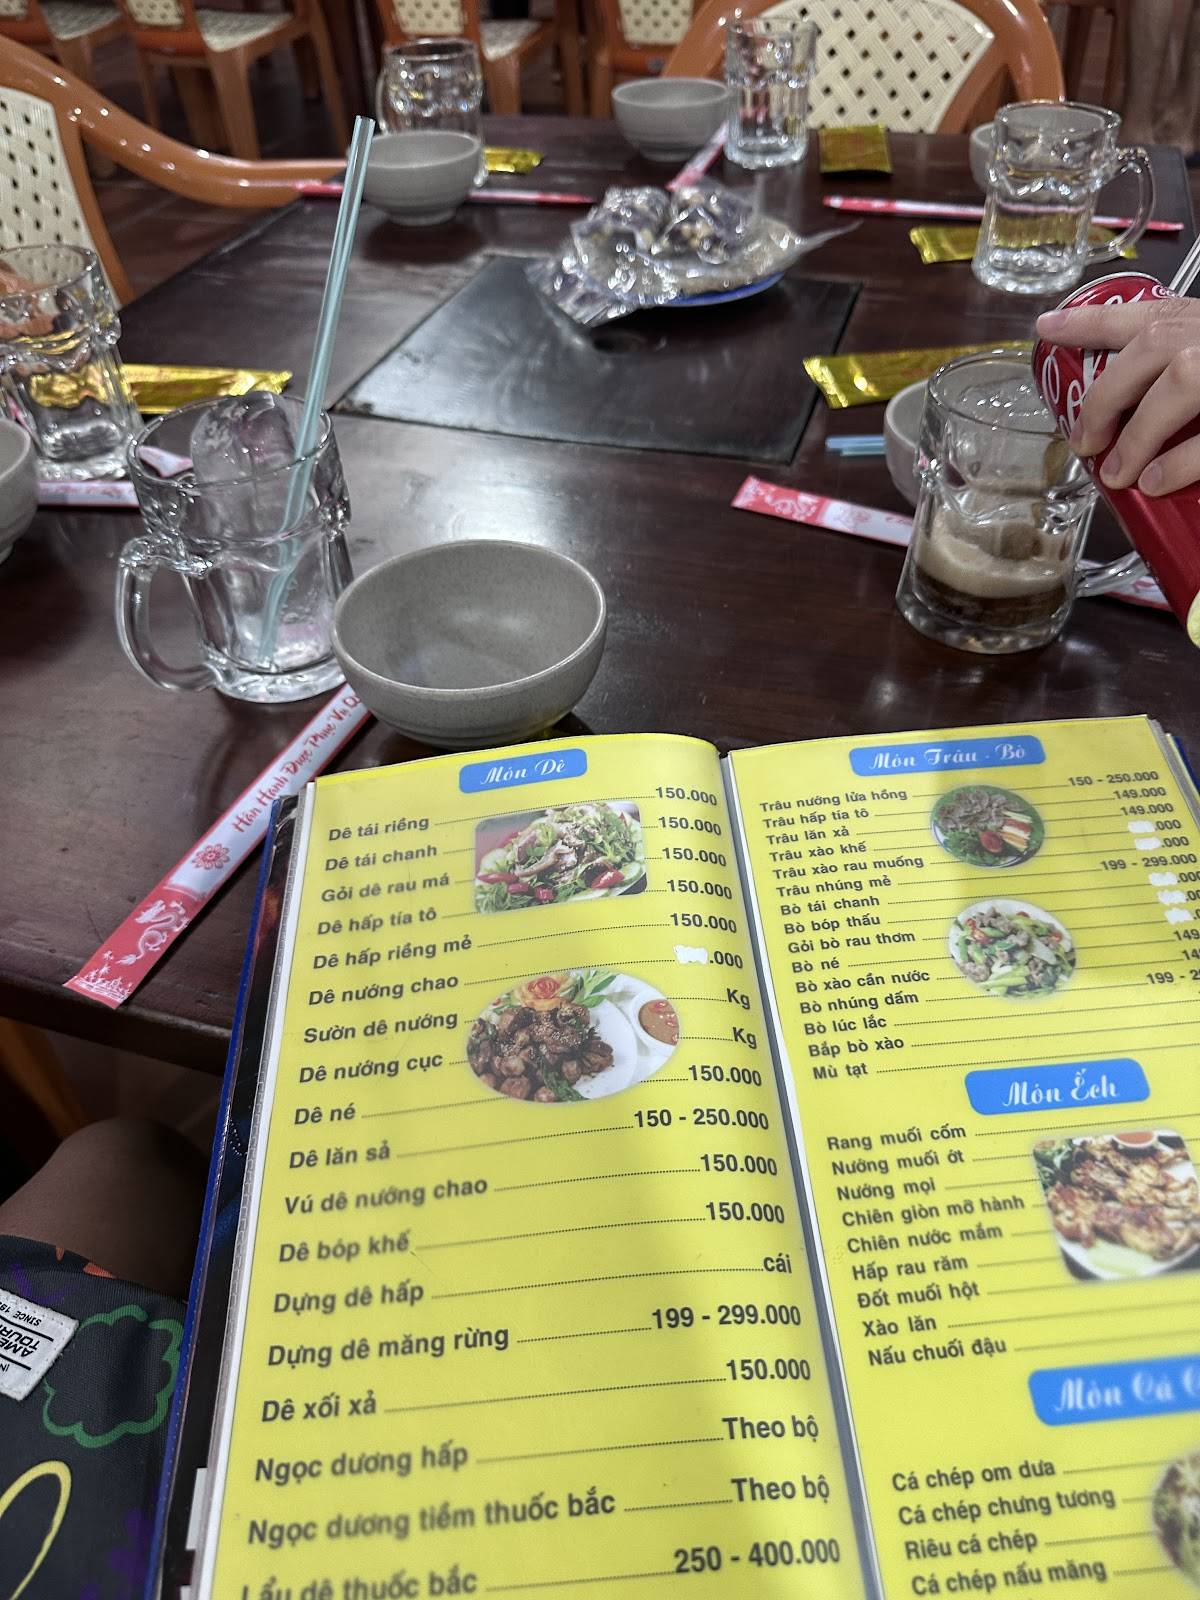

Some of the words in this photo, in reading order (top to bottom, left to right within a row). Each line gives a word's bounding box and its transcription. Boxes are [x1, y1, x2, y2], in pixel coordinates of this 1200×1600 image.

[535, 759, 565, 775] Dê
[760, 802, 791, 812] Trâu
[797, 796, 840, 808] nướng
[1068, 776, 1093, 786] 150
[1106, 771, 1159, 784] 250.000
[232, 807, 261, 832] Hân
[329, 828, 352, 841] Dê
[358, 824, 378, 837] tái
[656, 787, 717, 806] 150.000
[763, 818, 795, 828] Trâu
[800, 811, 826, 825] hấp
[855, 808, 869, 818] tô
[1114, 787, 1166, 799] 149.000
[766, 834, 798, 845] Trâu
[805, 829, 826, 840] lăn
[833, 826, 849, 837] xả
[1121, 802, 1174, 816] 149.000
[325, 857, 348, 871] Dê
[355, 853, 376, 867] tái
[383, 845, 437, 864] chanh
[658, 817, 722, 836] 150.000
[321, 887, 352, 902] Gỏi
[359, 883, 381, 898] dê
[388, 881, 416, 893] rau
[423, 873, 449, 888] má
[663, 848, 726, 867] 150.000
[773, 868, 805, 879] Trâu
[812, 863, 838, 875] xào
[844, 861, 867, 871] rau
[777, 886, 810, 897] Trâu
[816, 879, 863, 893] nhúng
[1100, 859, 1126, 870] 199
[1142, 853, 1197, 867] 299.000
[318, 920, 342, 934] Dê
[349, 915, 383, 931] hấp
[419, 908, 436, 921] tô
[667, 880, 732, 899] 150.000
[313, 955, 338, 969] Dê
[345, 948, 380, 966] hấp
[670, 912, 737, 933] 150.000
[788, 940, 813, 953] Gỏi
[820, 938, 840, 950] bò
[846, 936, 870, 947] rau
[876, 932, 915, 943] thơm
[792, 961, 813, 973] Bò
[821, 958, 839, 969] né
[309, 990, 335, 1005] Dê
[342, 984, 403, 1002] nướng
[411, 976, 458, 993] chao
[796, 981, 817, 993] Bò
[824, 978, 851, 990] xào
[892, 970, 930, 983] nước
[304, 1026, 356, 1043] Sườn
[363, 1020, 387, 1036] dê
[395, 1013, 457, 1032] nướng
[727, 988, 750, 1010] Kg
[800, 1001, 821, 1014] Bò
[828, 997, 878, 1011] nhúng
[885, 991, 918, 1005] dấm
[804, 1022, 826, 1035] Bò
[833, 1019, 856, 1032] lúc
[300, 1067, 327, 1083] Dê
[334, 1061, 399, 1079] nướng
[407, 1055, 443, 1072] cục
[733, 1027, 757, 1049] Kg
[848, 1040, 868, 1052] bò
[875, 1037, 904, 1050] xào
[813, 1067, 838, 1080] Mù
[846, 1063, 868, 1078] tạt
[295, 1108, 322, 1125] Dê
[330, 1103, 355, 1121] né
[689, 1065, 761, 1087] 150.000
[289, 1152, 318, 1168] Dê
[326, 1148, 358, 1166] lăn
[366, 1140, 390, 1162] sả
[634, 1109, 671, 1127] 150
[693, 1108, 769, 1130] 250.000
[828, 1136, 872, 1150] Rang
[881, 1128, 922, 1144] muối
[930, 1124, 966, 1139] cốm
[897, 1150, 939, 1168] muối
[948, 1150, 964, 1163] ớt
[285, 1194, 313, 1214] Vú
[321, 1192, 348, 1211] dê
[355, 1187, 425, 1207] nướng
[433, 1179, 487, 1199] chao
[701, 1154, 777, 1176] 150.000
[904, 1178, 935, 1194] mọi
[706, 1202, 785, 1224] 150.000
[764, 1253, 792, 1274] cái
[852, 1262, 888, 1282] Hấp
[897, 1260, 925, 1275] rau
[13, 1311, 41, 1326] SINCE
[863, 1318, 899, 1336] Xào
[909, 1316, 936, 1332] lăn
[0, 1324, 40, 1350] TOUR
[268, 1343, 332, 1368] Dựng
[341, 1338, 369, 1362] dê
[378, 1333, 445, 1357] măng
[454, 1327, 509, 1350] rừng
[652, 1307, 694, 1329] 199
[718, 1304, 801, 1325] 299.000
[868, 1347, 905, 1366] Nấu
[913, 1339, 964, 1361] chuối
[261, 1399, 295, 1422] Dê
[303, 1393, 339, 1419] xối
[348, 1390, 376, 1416] xả
[726, 1359, 811, 1381] 150.000
[254, 1457, 322, 1486] Ngọc
[421, 1440, 468, 1471] hấp
[722, 1416, 785, 1440] Theo
[792, 1415, 818, 1443] bộ
[731, 1478, 796, 1502] Theo
[803, 1475, 829, 1504] bộ
[893, 1469, 918, 1491] Cá
[925, 1467, 974, 1489] chép
[981, 1465, 1012, 1482] om
[1019, 1460, 1055, 1477] dưa
[899, 1504, 925, 1525] Cá
[932, 1500, 981, 1522] chép
[674, 1546, 721, 1574] 250
[749, 1538, 840, 1568] 400.000
[905, 1538, 951, 1560] Riêu
[958, 1534, 981, 1555] cá
[988, 1529, 1038, 1551] chép
